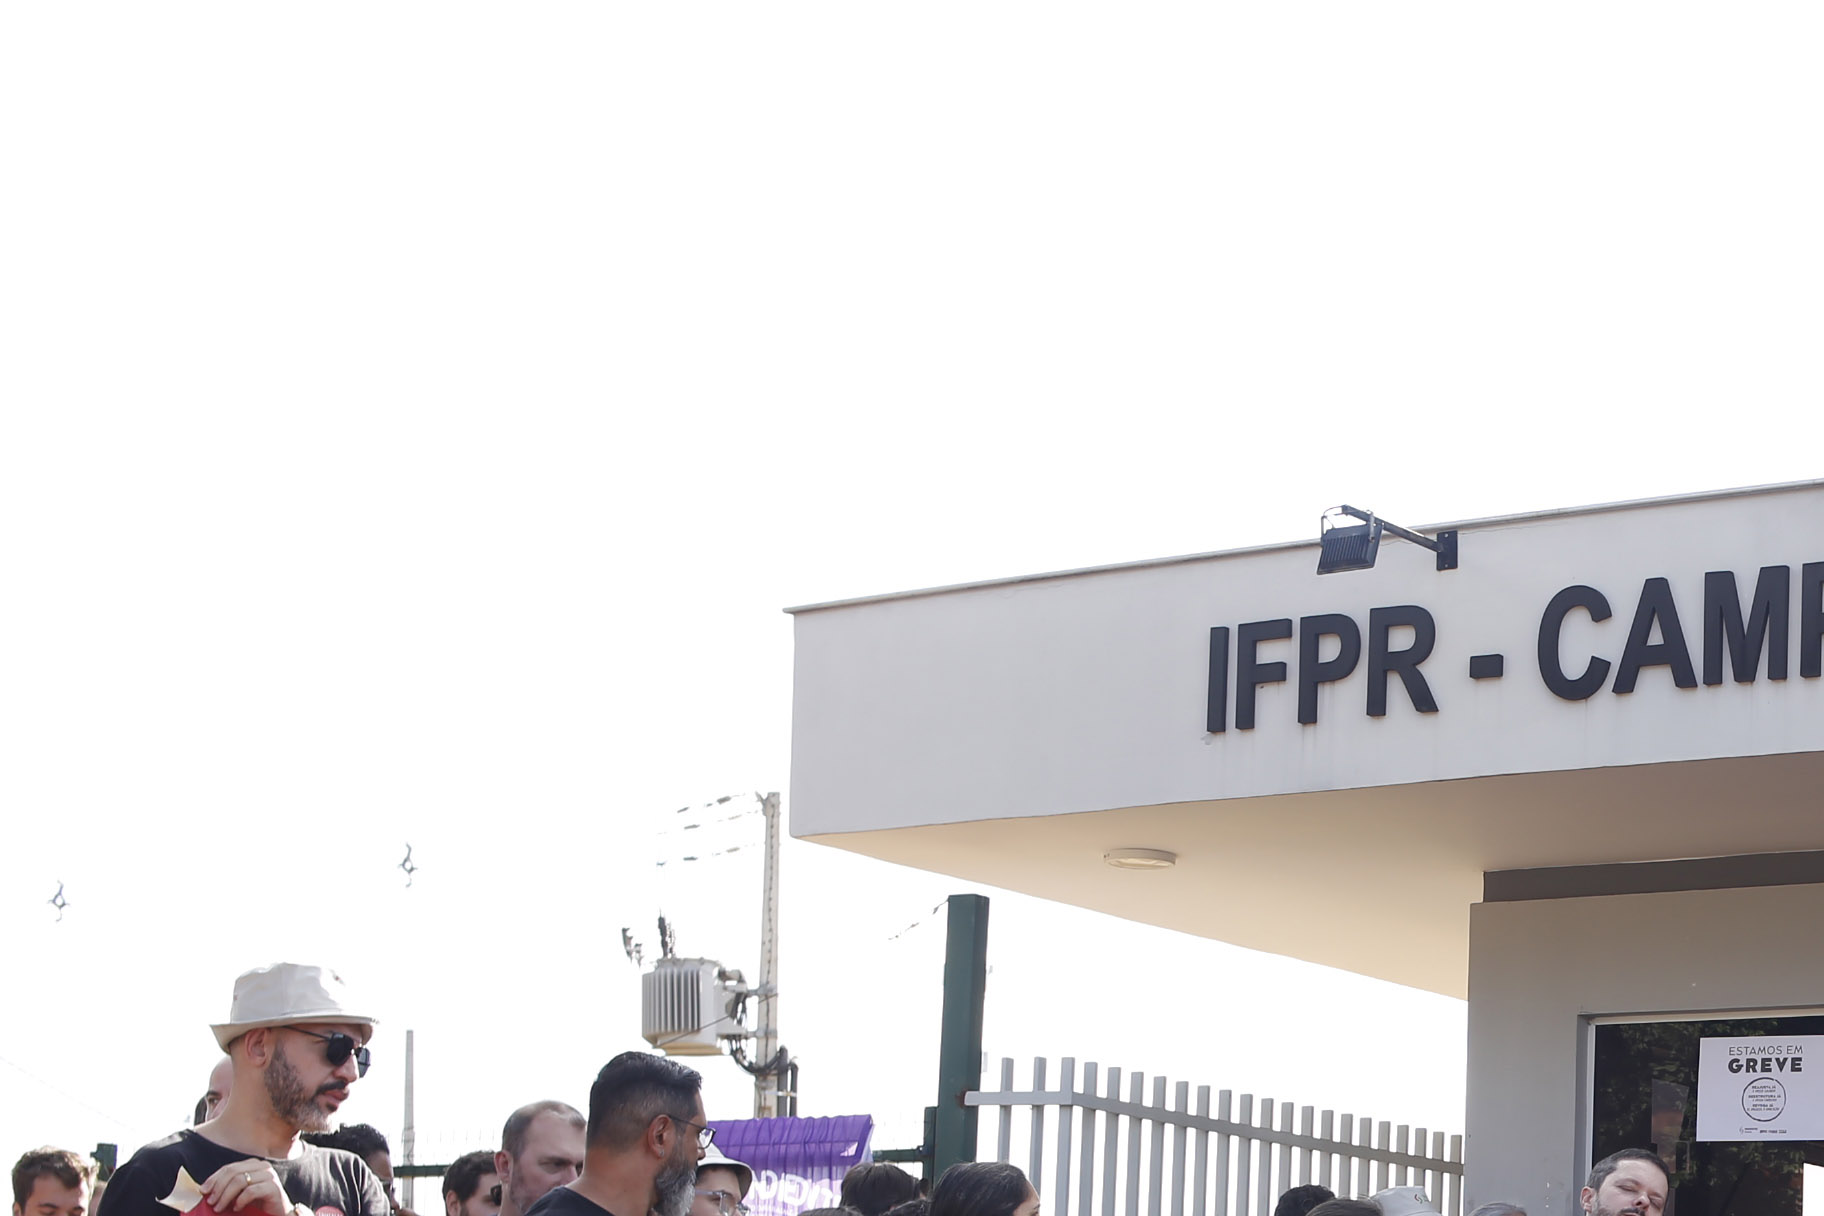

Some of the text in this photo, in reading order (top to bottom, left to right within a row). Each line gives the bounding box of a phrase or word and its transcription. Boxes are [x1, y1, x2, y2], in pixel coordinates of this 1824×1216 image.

[1207, 604, 1439, 733] IFPR
[1728, 1045, 1803, 1056] ESTAMOS EM
[1728, 1057, 1803, 1073] GREVE
